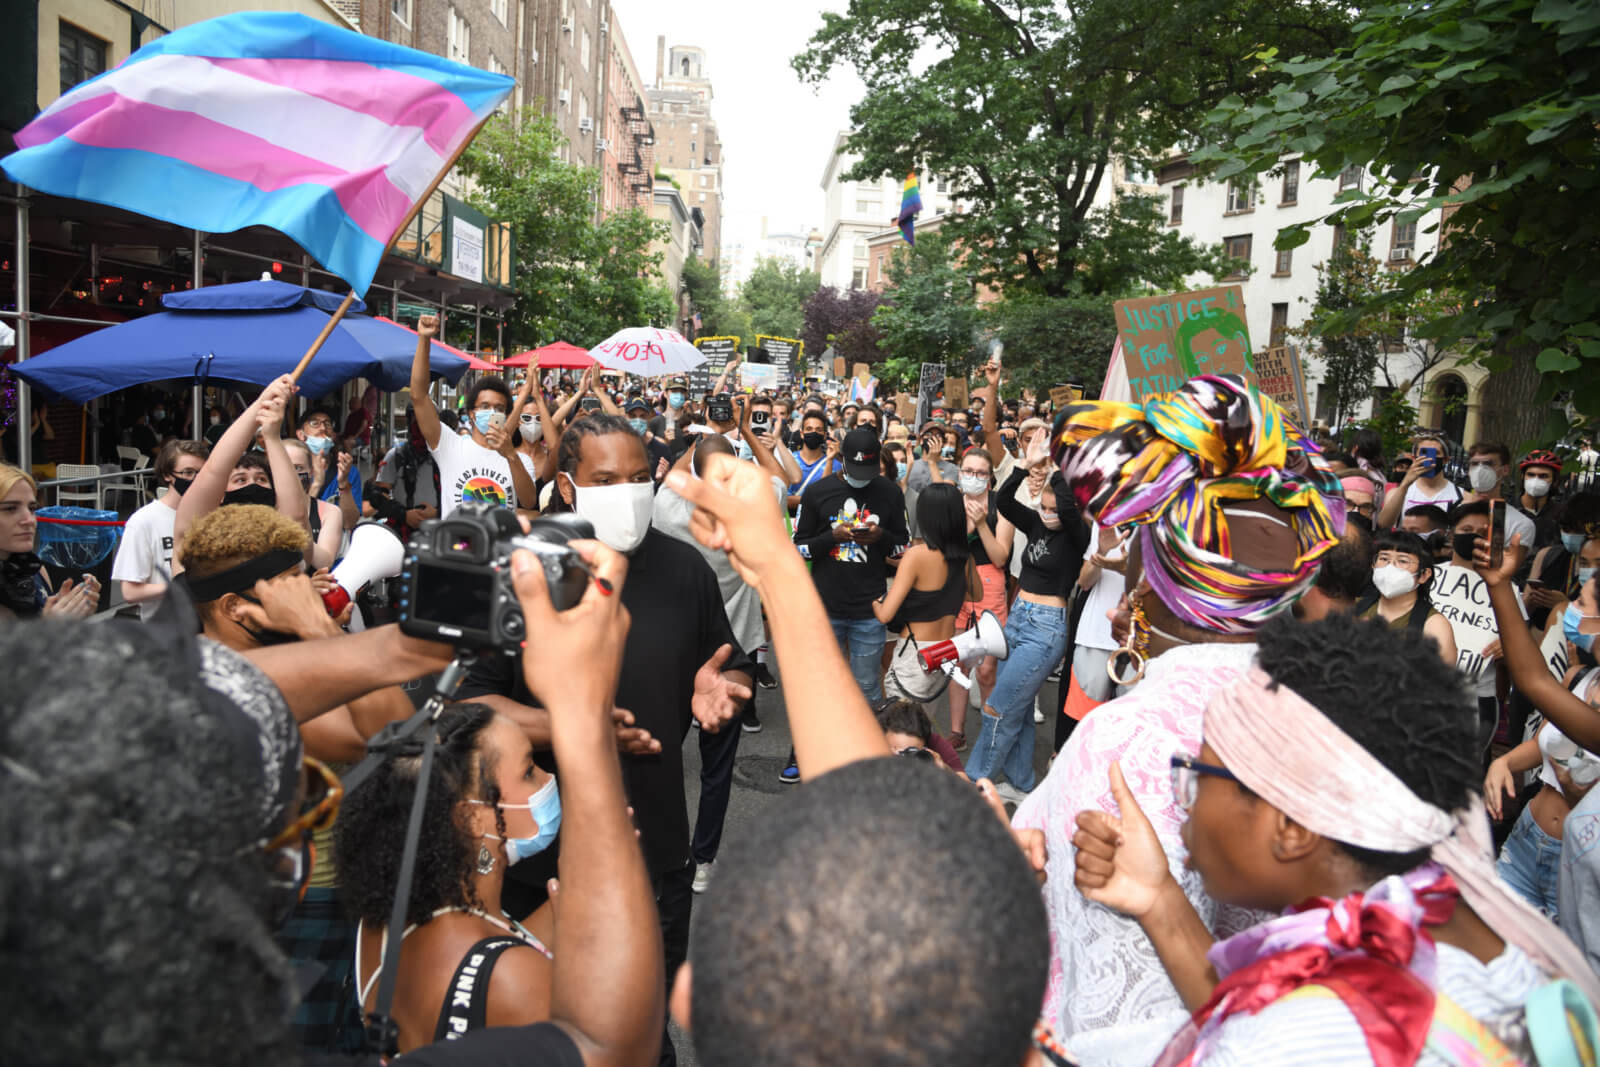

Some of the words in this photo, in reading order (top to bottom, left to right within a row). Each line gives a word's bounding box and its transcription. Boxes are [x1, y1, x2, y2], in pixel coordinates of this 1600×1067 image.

[1123, 296, 1217, 336] JUSTICE
[1138, 343, 1173, 371] FOR
[1253, 352, 1270, 361] SAY
[1275, 349, 1285, 358] IT
[1255, 359, 1283, 370] WITH
[1256, 367, 1289, 378] YOUR
[1258, 375, 1293, 386] WHOLE
[455, 467, 479, 490] BLACK
[481, 467, 508, 485] LIVES
[1430, 565, 1492, 608] BLAC
